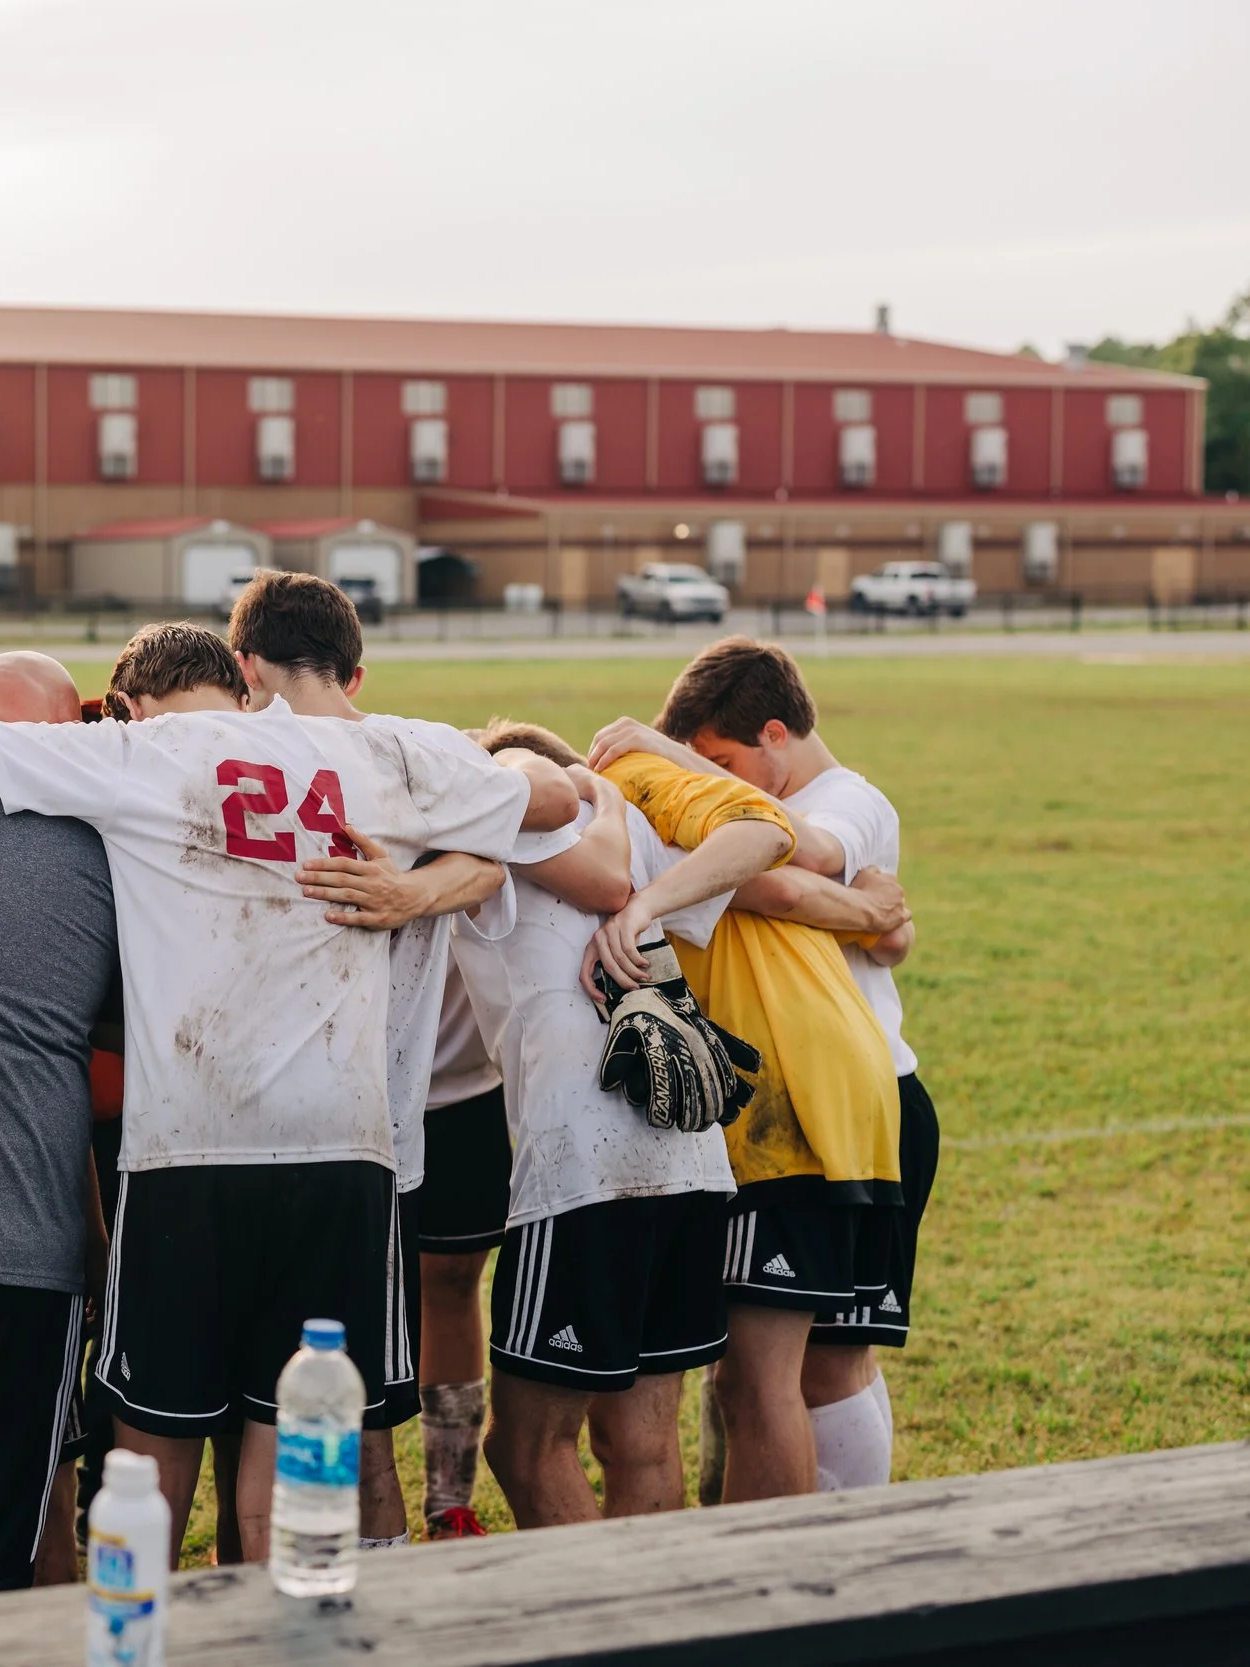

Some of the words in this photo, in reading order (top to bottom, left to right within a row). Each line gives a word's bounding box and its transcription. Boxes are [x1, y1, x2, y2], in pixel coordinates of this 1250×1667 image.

[216, 758, 358, 862] 24
[647, 1045, 671, 1123] LANZERA
[762, 1265, 796, 1278] adidas
[548, 1338, 583, 1353] adidas
